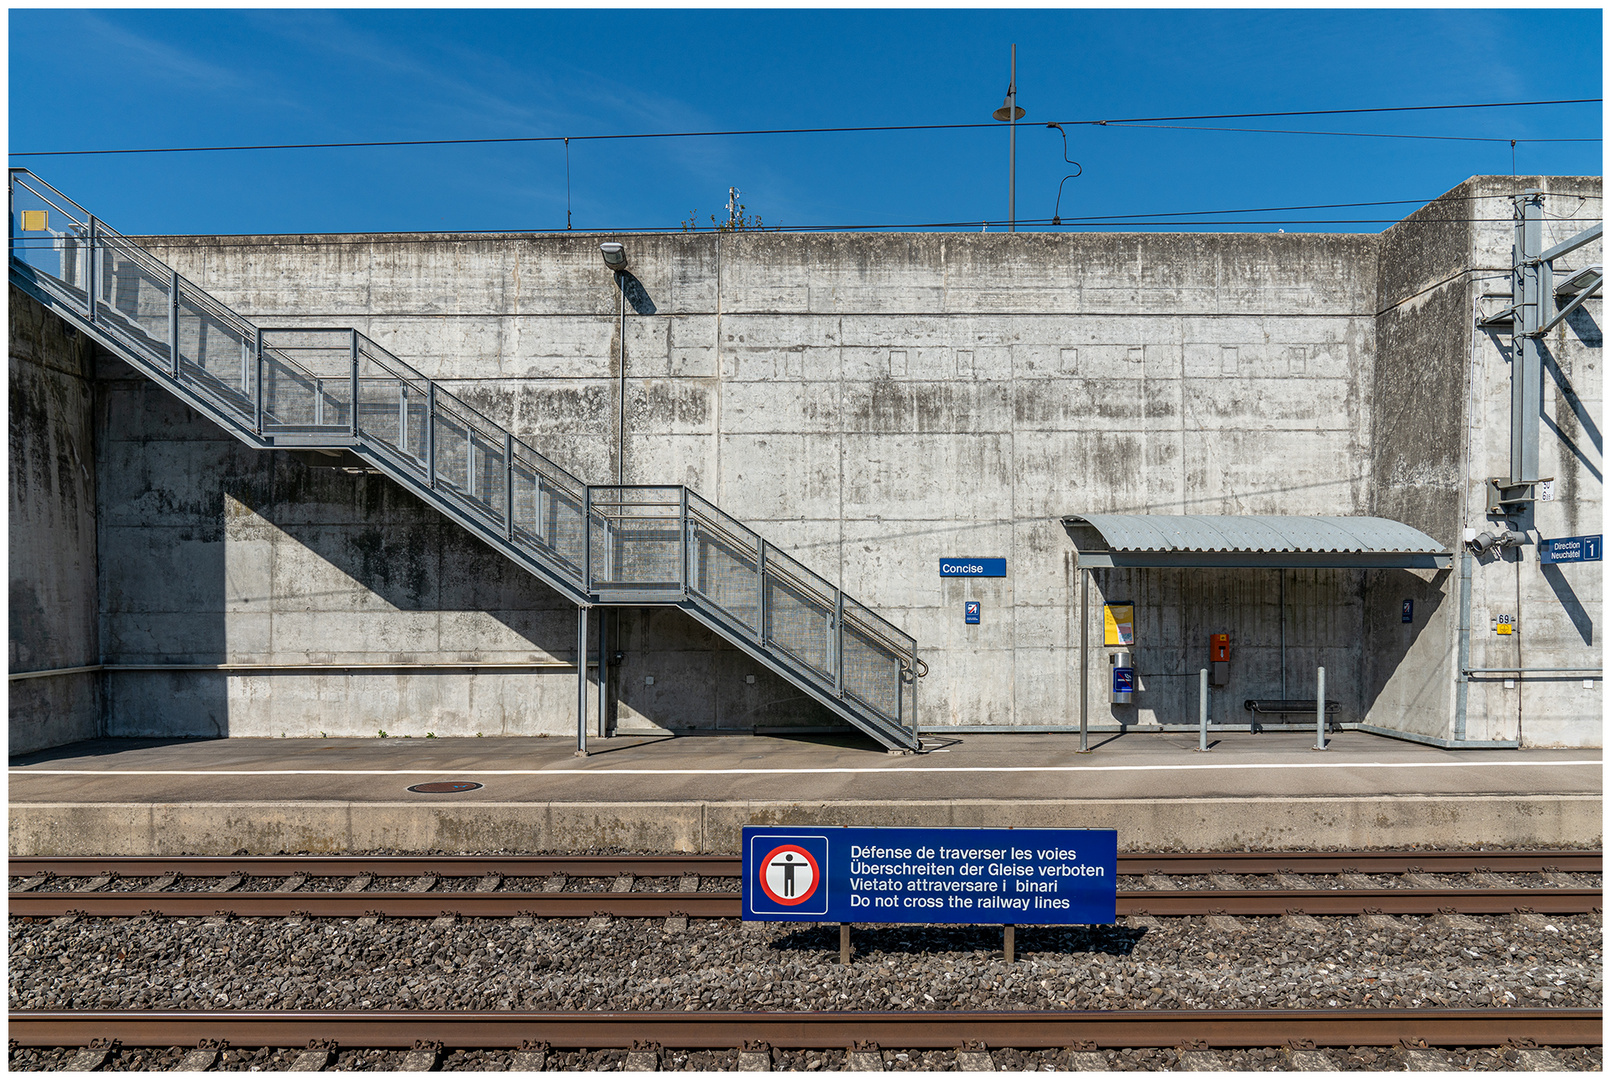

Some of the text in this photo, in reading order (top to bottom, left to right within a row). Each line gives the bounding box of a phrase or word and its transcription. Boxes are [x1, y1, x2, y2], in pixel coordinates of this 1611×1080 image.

[1554, 541, 1581, 551] Direction
[1589, 543, 1595, 557] 1
[1551, 550, 1581, 560] Neuchâtel
[942, 563, 984, 573] Concise
[1498, 614, 1509, 624] 69
[850, 845, 1077, 860] Défense de traverser les voies
[850, 858, 1104, 876] Überschreiten der Gleise verboten
[850, 878, 1058, 892] Vietato attraversare i binari
[850, 895, 1070, 911] Do not cross the railway lines
